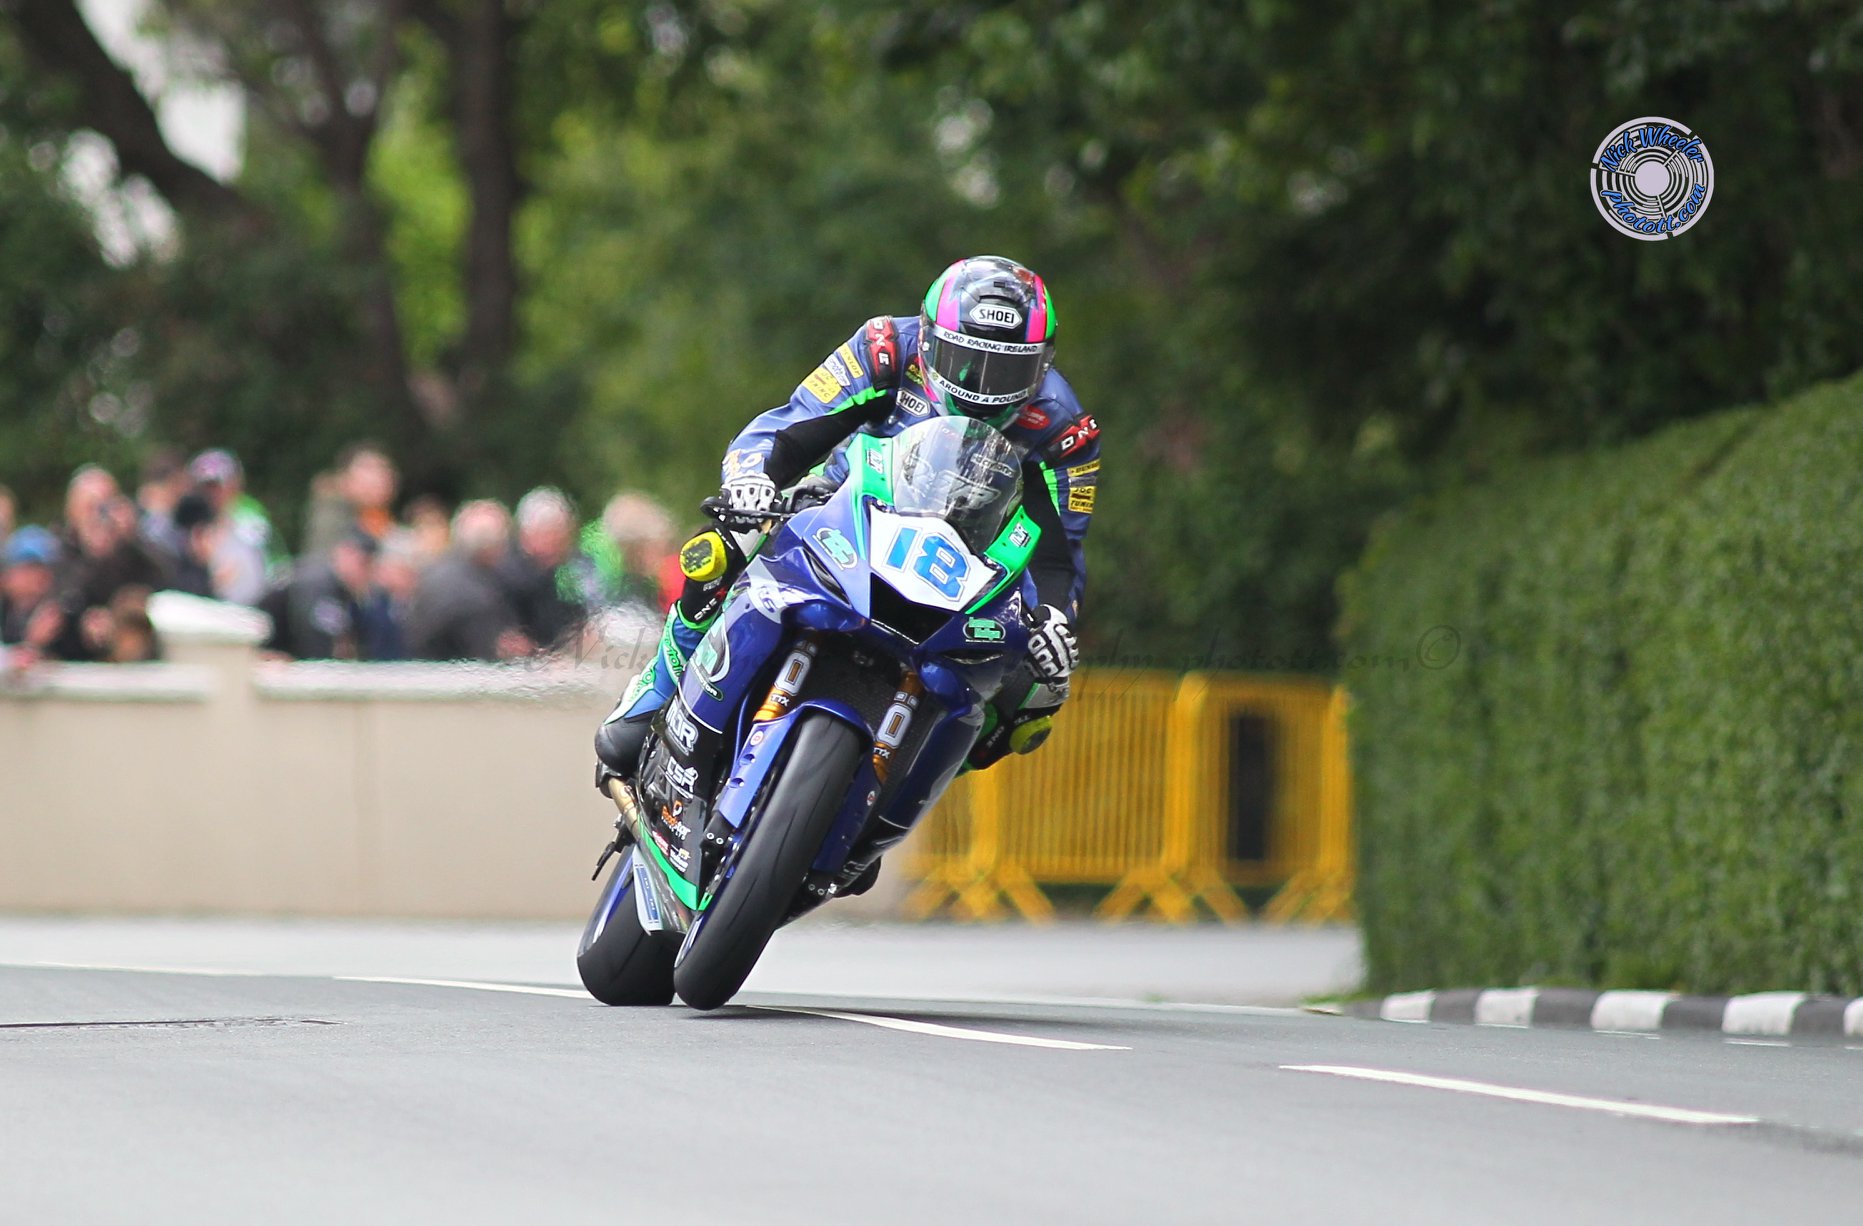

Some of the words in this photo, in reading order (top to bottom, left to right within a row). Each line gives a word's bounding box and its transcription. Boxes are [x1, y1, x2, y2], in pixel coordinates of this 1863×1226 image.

[979, 308, 1015, 324] SHOEI
[943, 331, 965, 343] ROAD
[967, 338, 1001, 351] RACING
[1003, 344, 1039, 353] IRELAND
[938, 378, 980, 402] AROUND
[982, 394, 991, 403] A
[992, 390, 1028, 403] POUND
[901, 391, 926, 414] SHOEI
[884, 525, 970, 601] 18
